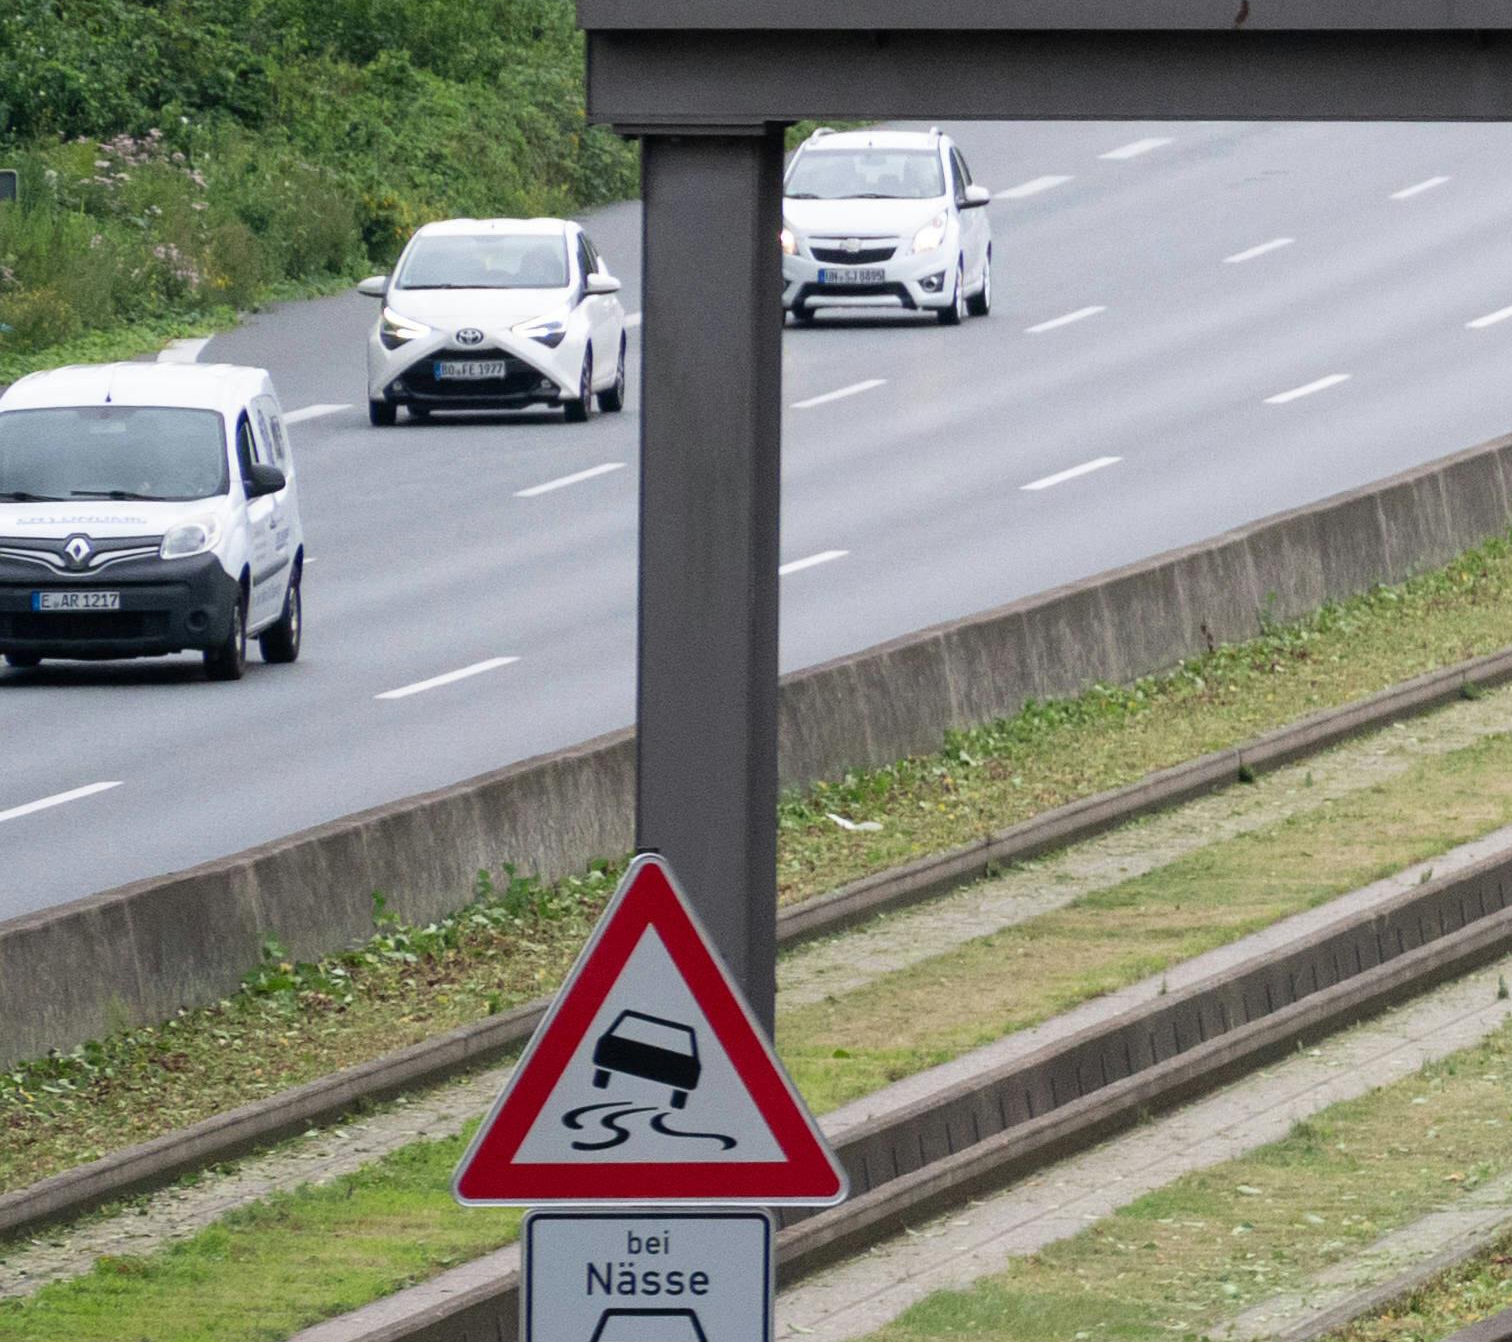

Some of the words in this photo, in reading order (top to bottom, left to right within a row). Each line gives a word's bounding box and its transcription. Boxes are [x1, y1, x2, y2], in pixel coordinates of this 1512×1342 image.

[41, 594, 50, 608] E
[60, 594, 79, 608] AR
[82, 594, 118, 608] 1217
[626, 1230, 670, 1257] bei
[585, 1262, 709, 1296] Nässe
